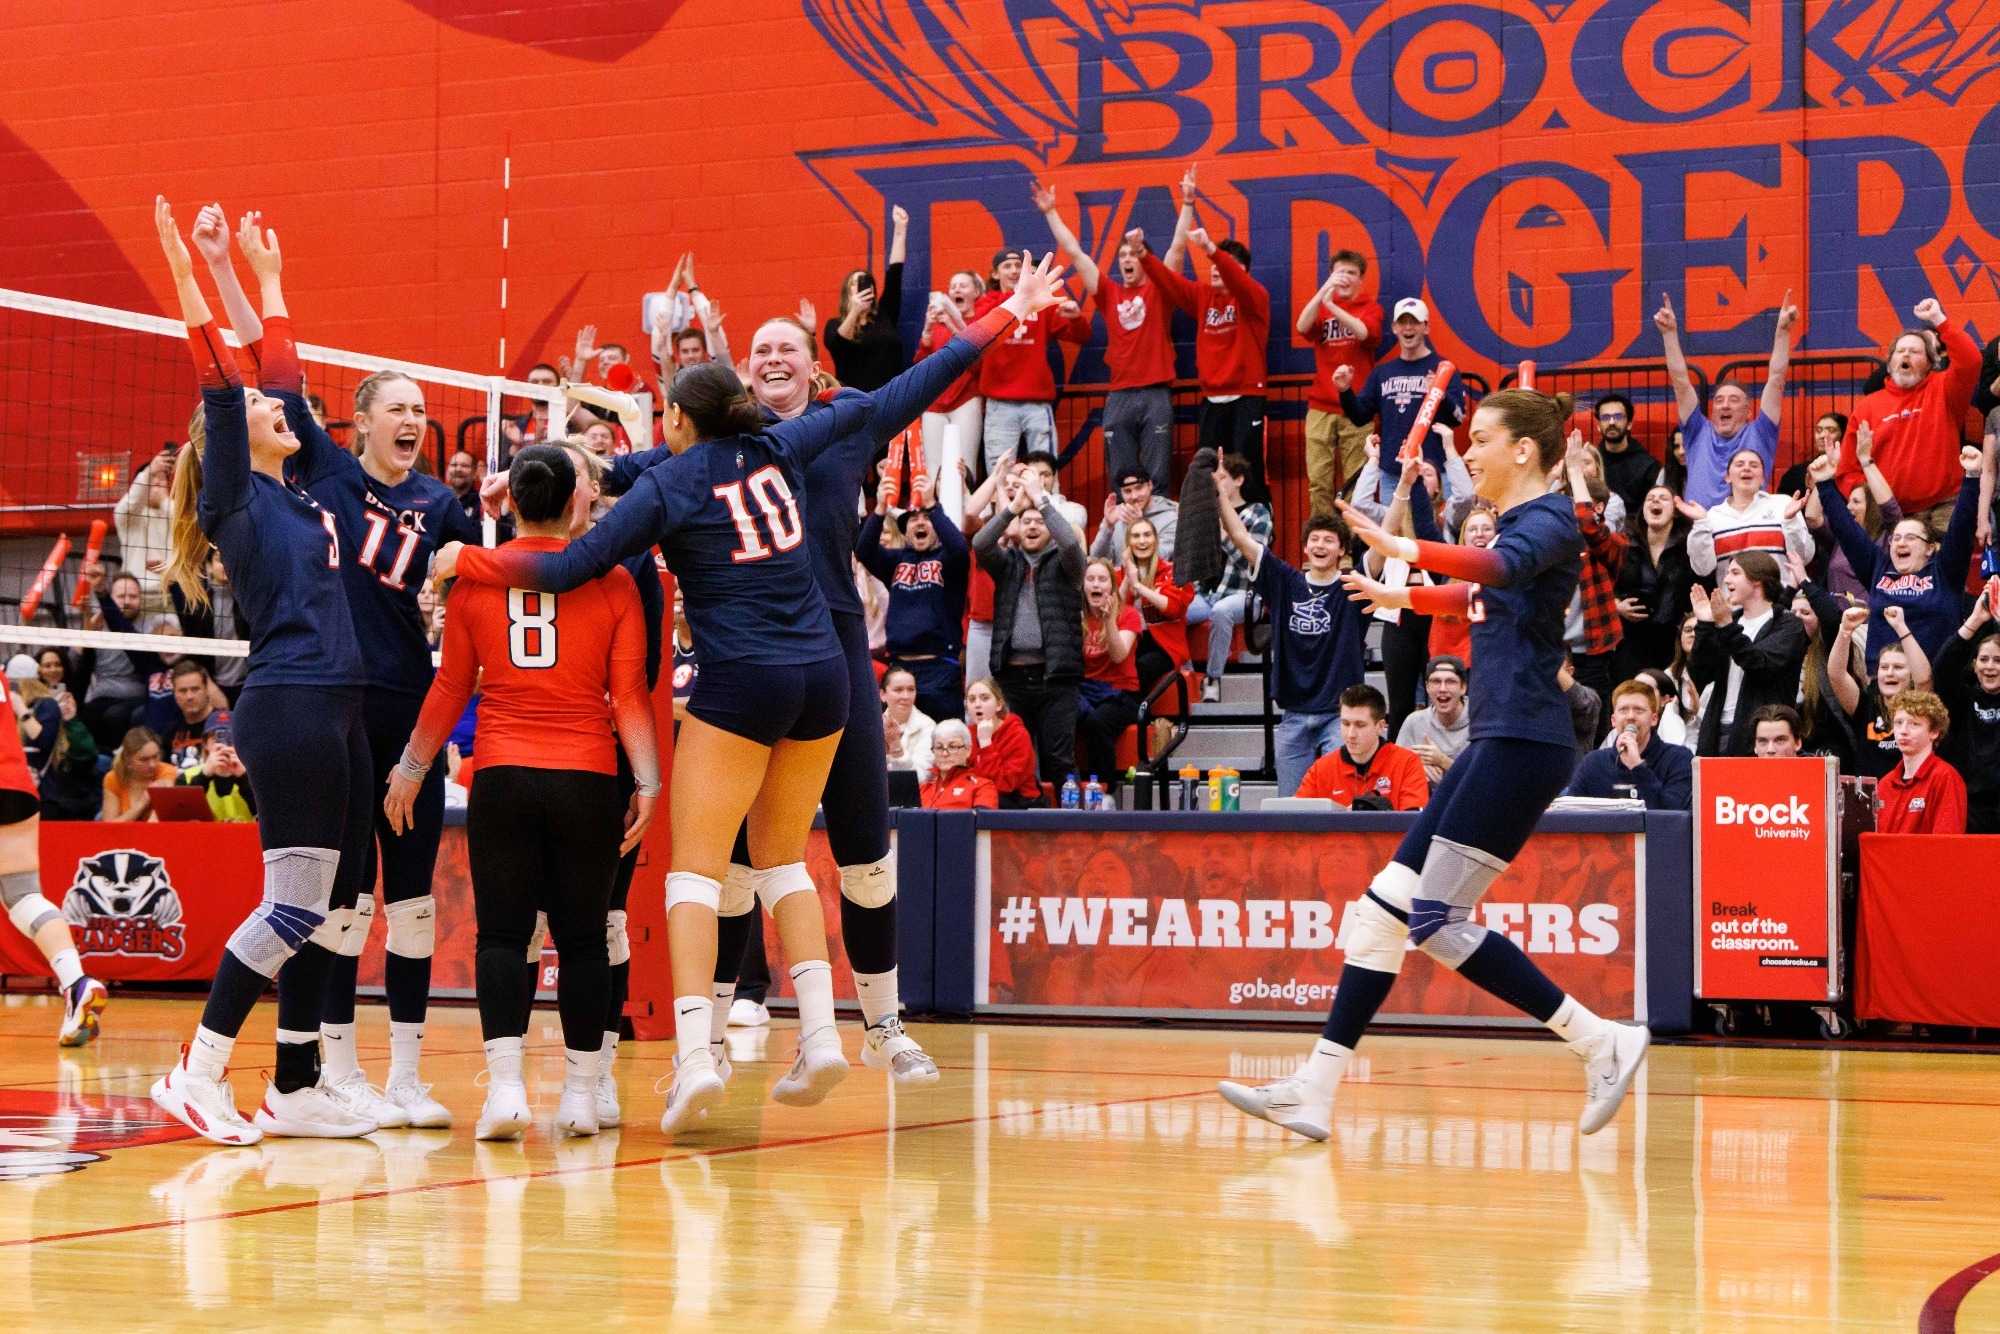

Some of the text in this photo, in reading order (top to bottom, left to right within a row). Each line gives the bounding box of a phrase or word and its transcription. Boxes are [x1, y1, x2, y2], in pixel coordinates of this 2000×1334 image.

[1057, 0, 1898, 165] BROCK
[712, 464, 803, 563] 10
[358, 509, 420, 591] 11
[507, 587, 558, 670] 8
[1716, 796, 1810, 825] Brock
[1755, 827, 1810, 841] University
[1711, 902, 1758, 916] Break
[1711, 918, 1788, 934] out of the
[1711, 934, 1799, 951] classroom.
